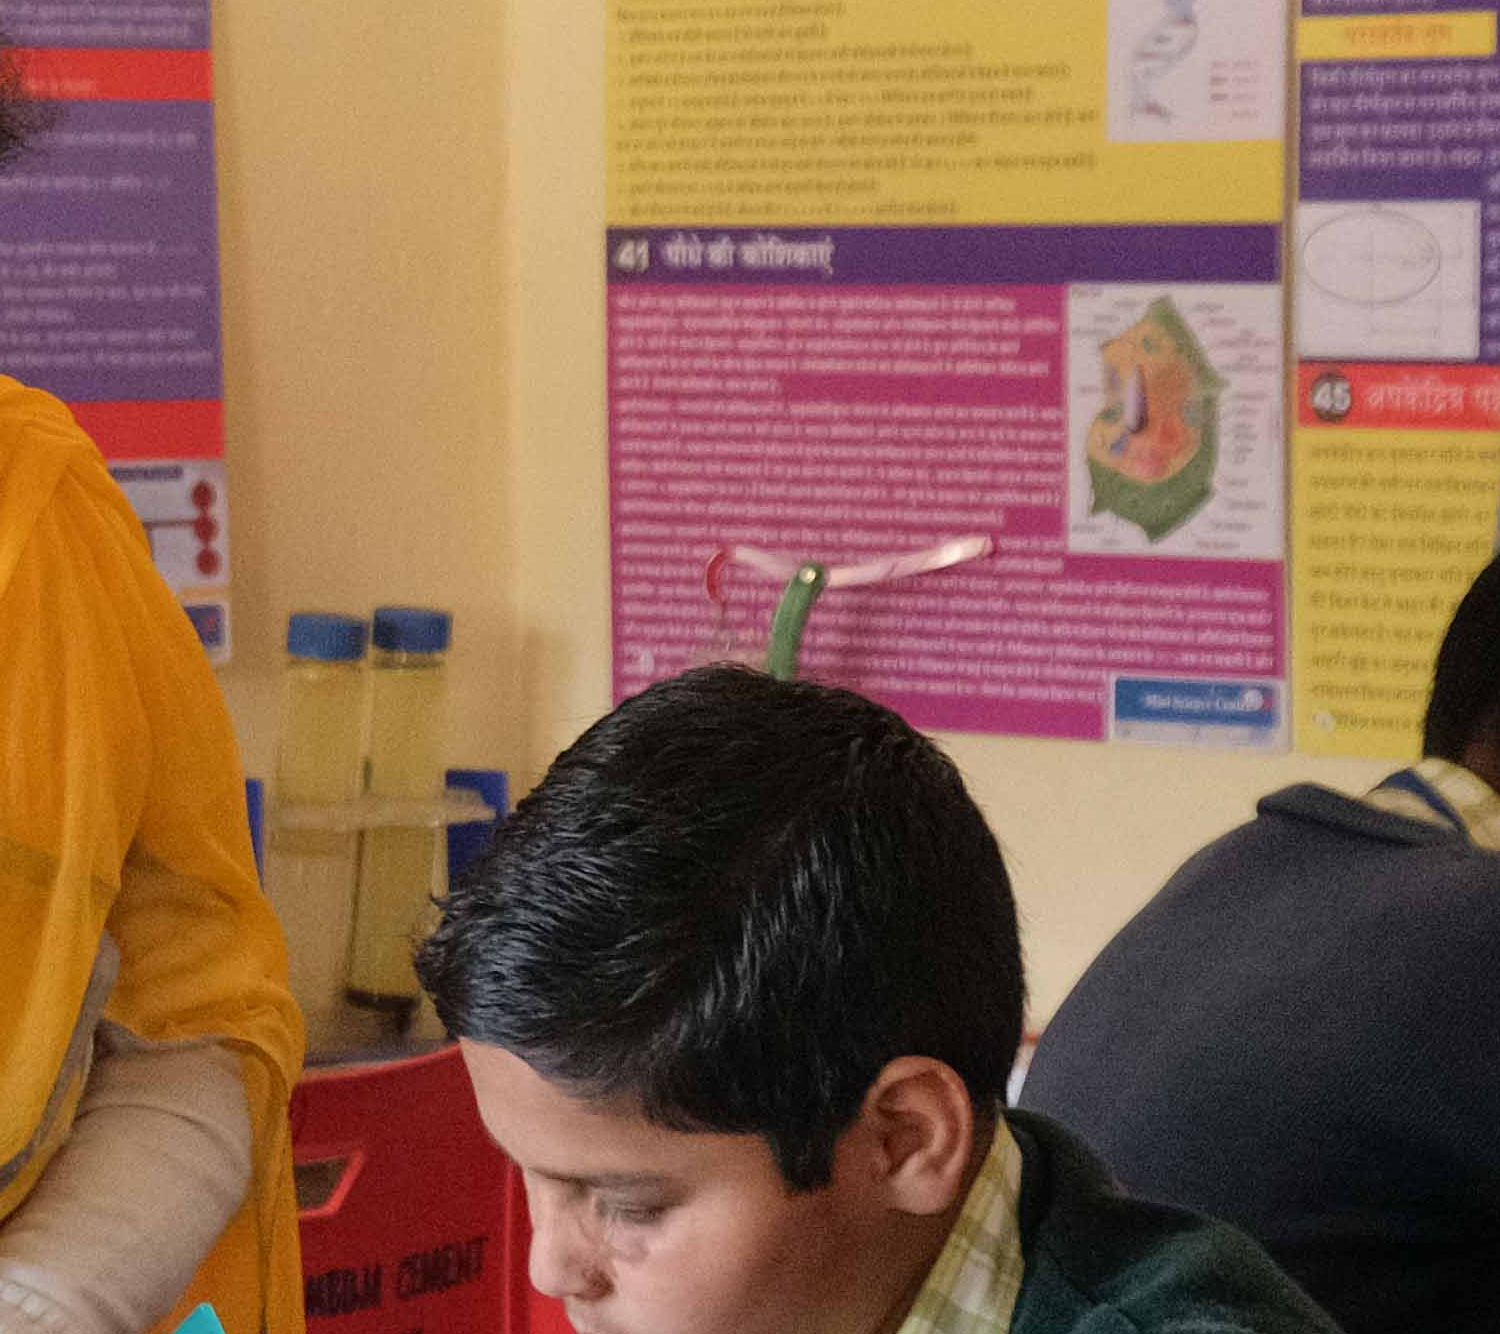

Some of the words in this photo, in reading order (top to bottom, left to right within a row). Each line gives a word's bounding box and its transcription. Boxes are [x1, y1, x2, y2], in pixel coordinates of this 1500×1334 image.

[618, 241, 649, 269] 41
[1315, 382, 1350, 411] 45
[395, 1236, 489, 1301] CEMENT
